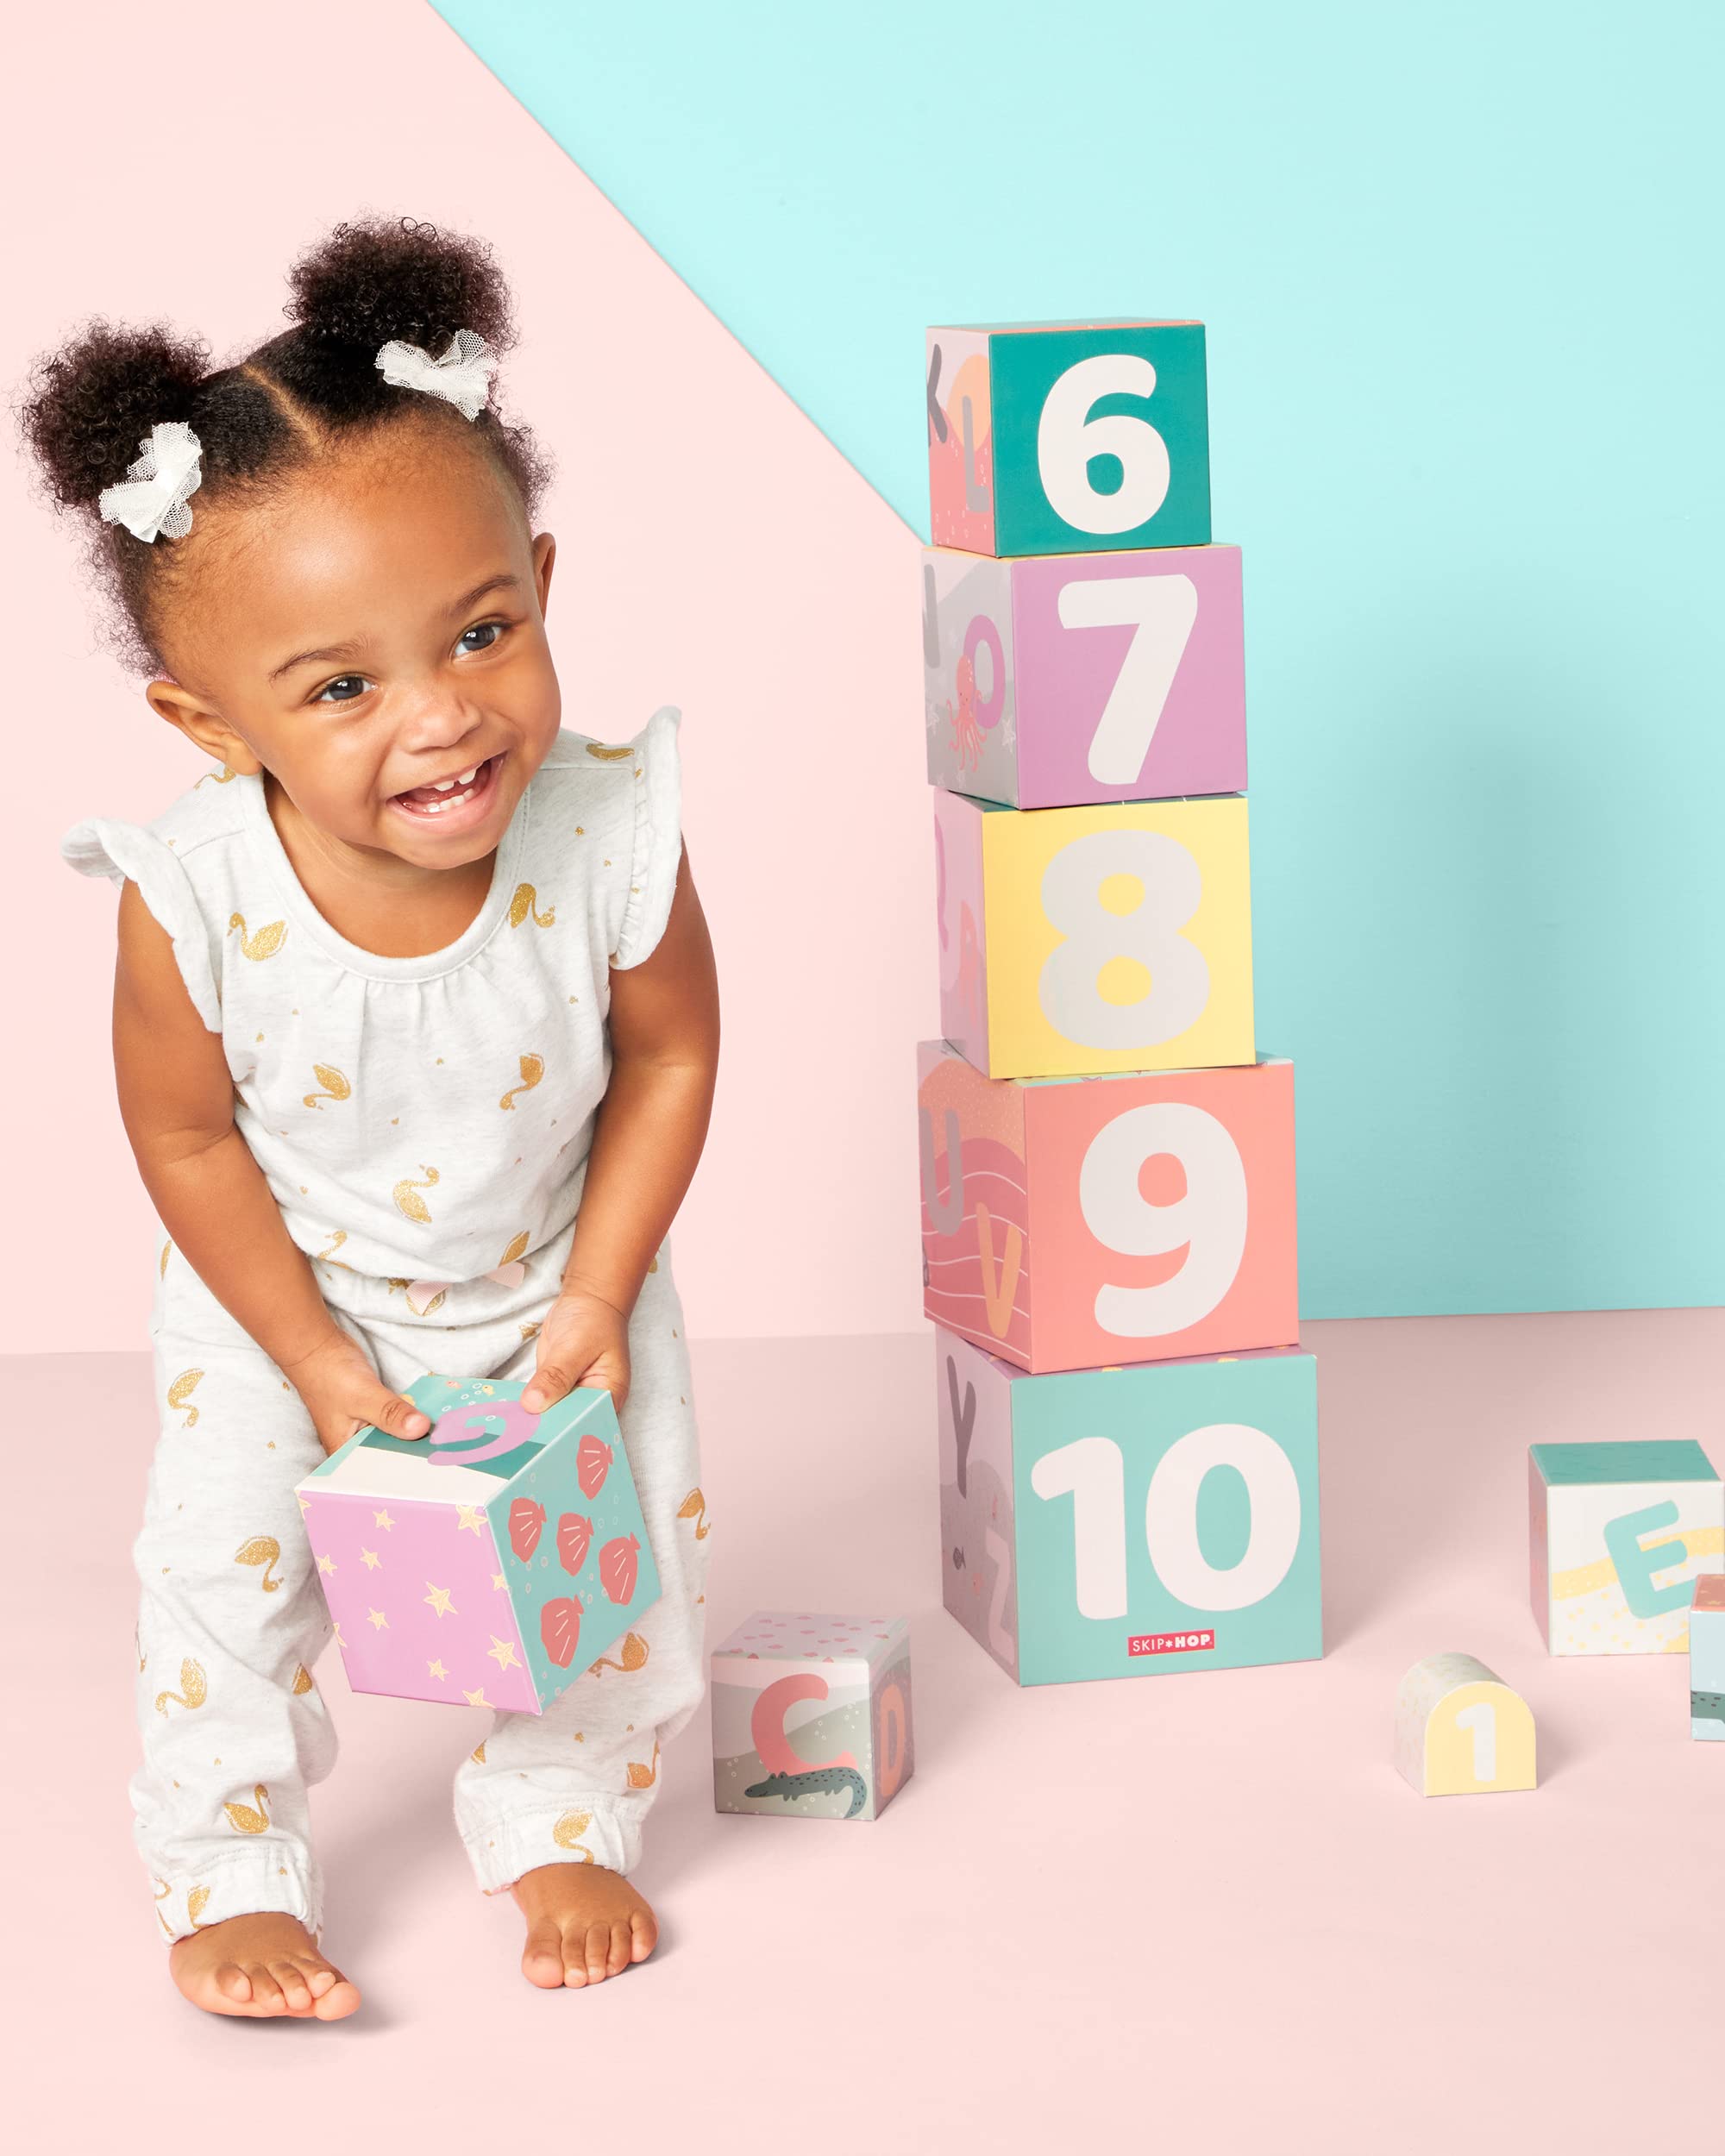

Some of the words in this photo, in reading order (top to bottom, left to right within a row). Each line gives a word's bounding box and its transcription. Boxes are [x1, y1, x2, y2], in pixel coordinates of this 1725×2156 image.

[962, 395, 990, 513] L
[1038, 354, 1171, 534] 6
[1057, 573, 1198, 785] 7
[1038, 830, 1212, 1050] 8
[919, 1107, 964, 1237] U
[1079, 1102, 1248, 1338] 9
[975, 1201, 1022, 1339] V
[946, 1354, 976, 1499] Y
[1031, 1423, 1302, 1620] 10
[1603, 1499, 1696, 1620] E
[750, 1673, 859, 1779] C
[1456, 1702, 1496, 1783] 1
